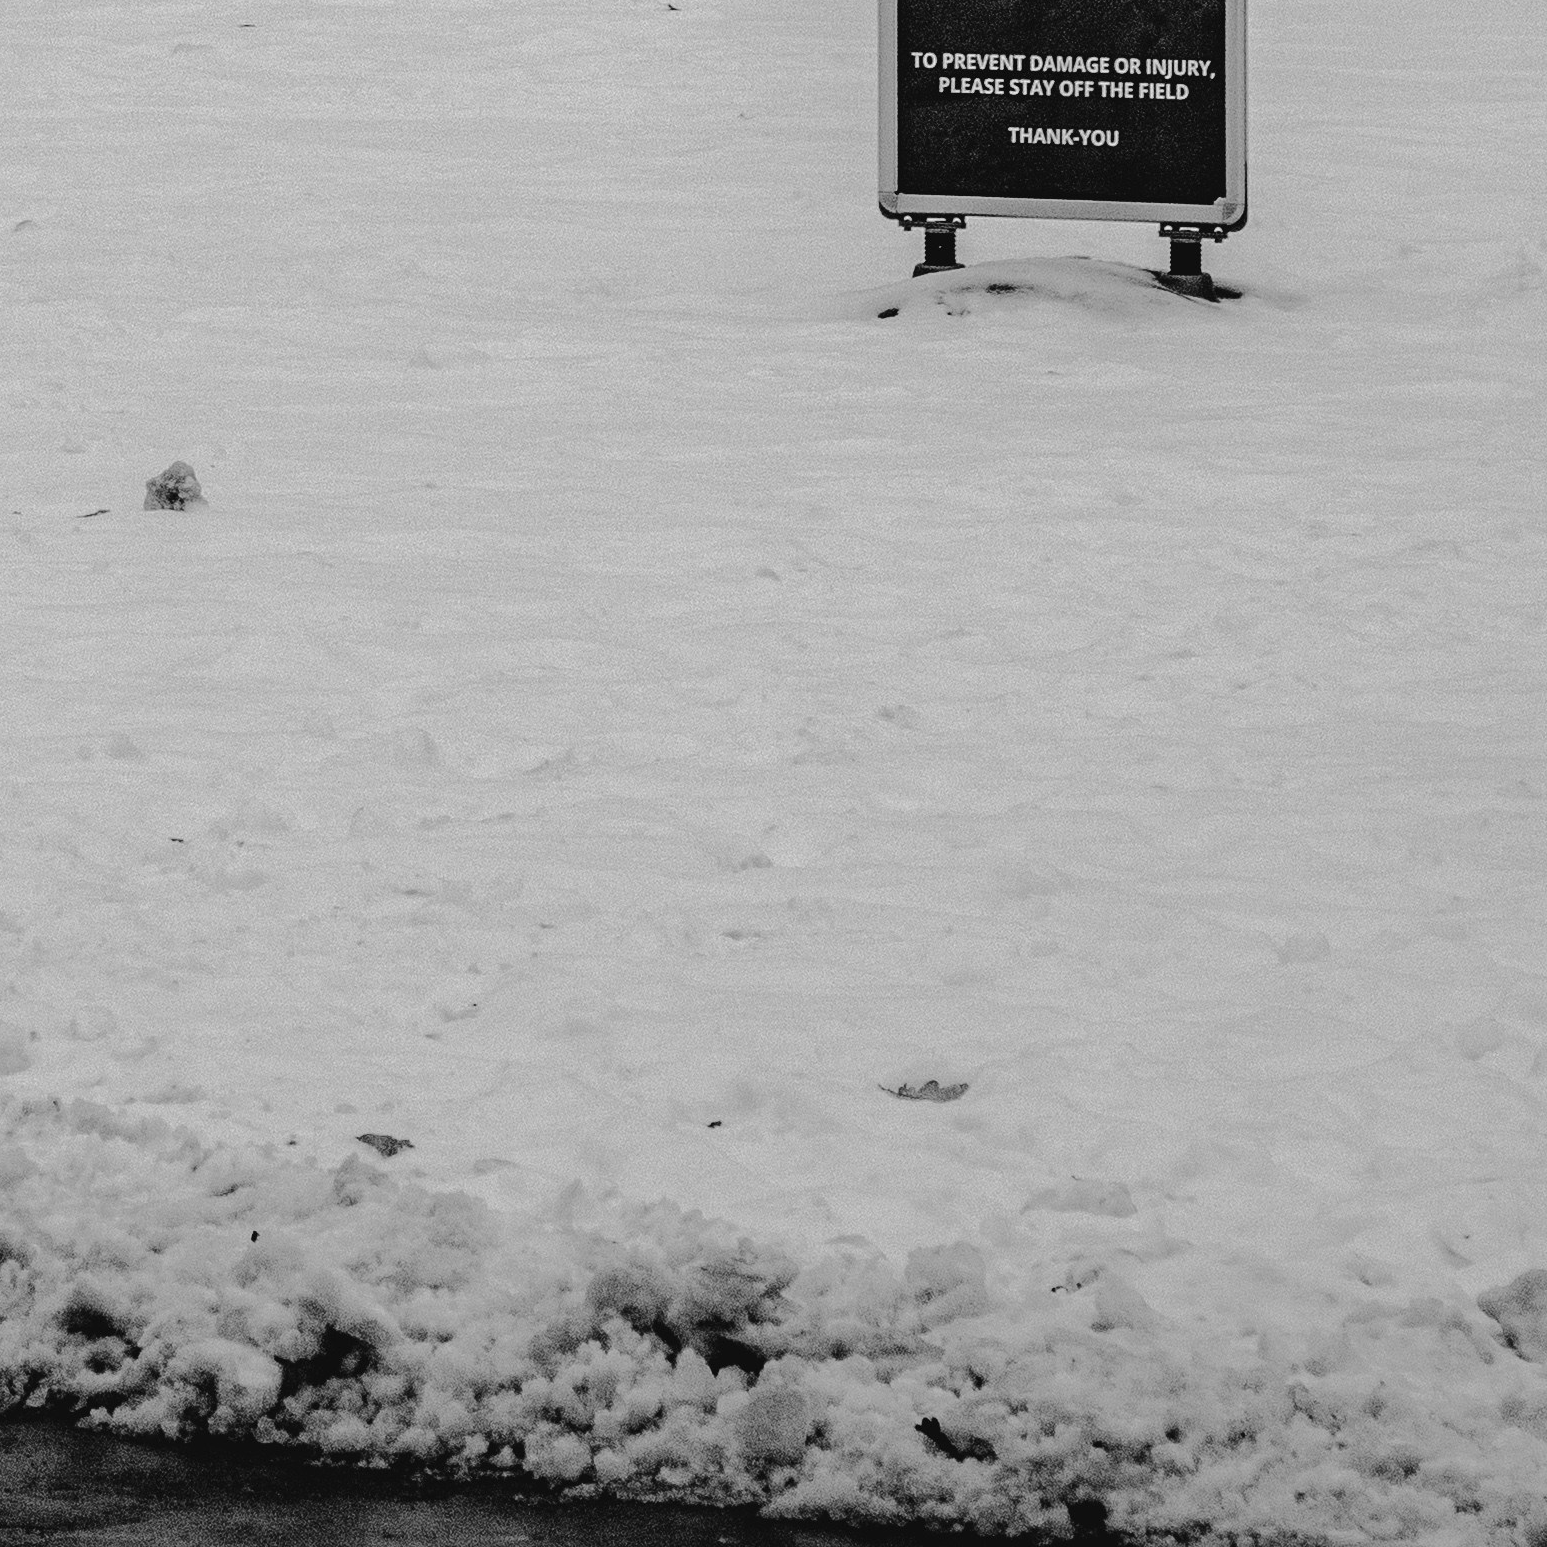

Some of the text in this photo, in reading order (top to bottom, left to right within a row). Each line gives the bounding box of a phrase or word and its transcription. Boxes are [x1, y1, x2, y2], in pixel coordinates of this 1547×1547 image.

[911, 51, 1216, 80] TO PREVENT DAMAGE OR INJURY,
[938, 76, 1190, 101] PLEASE STAY OFF THE FIELD
[1007, 126, 1120, 147] THANK-YOU
